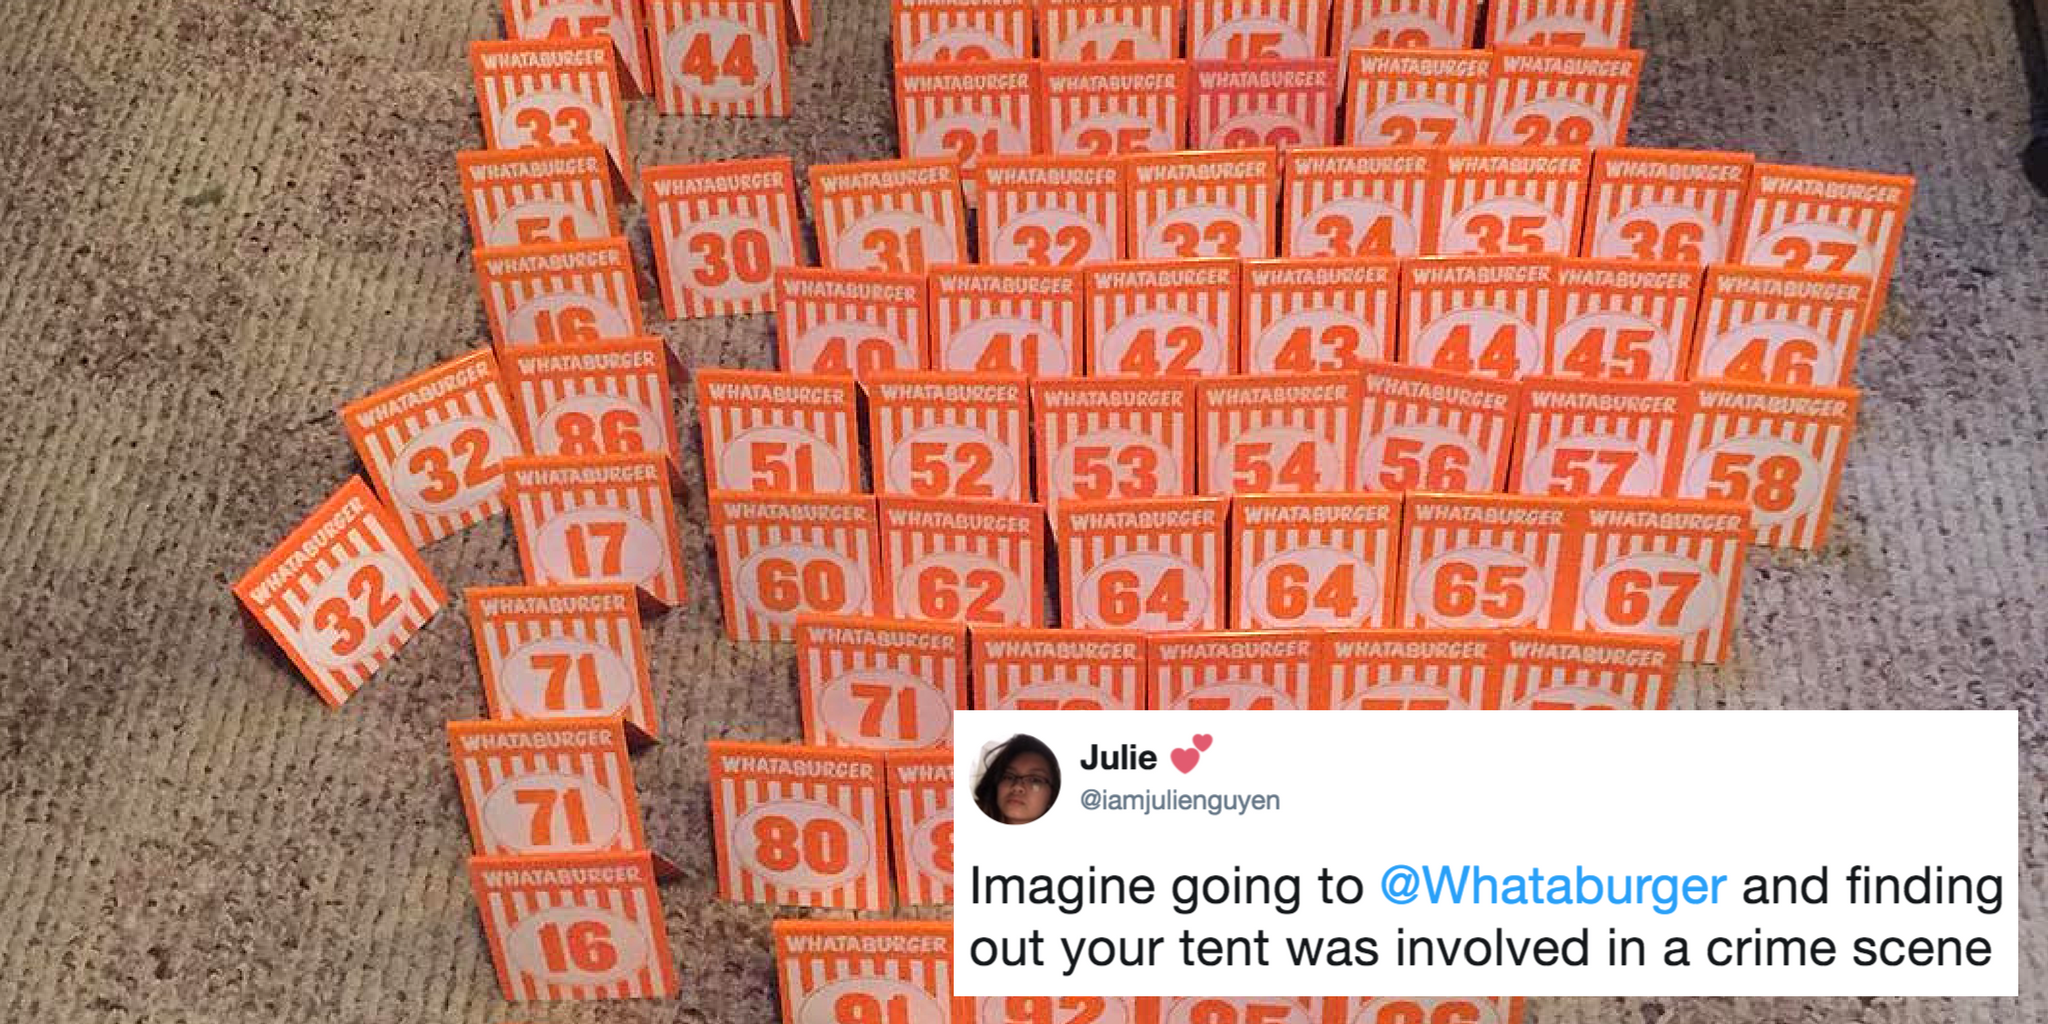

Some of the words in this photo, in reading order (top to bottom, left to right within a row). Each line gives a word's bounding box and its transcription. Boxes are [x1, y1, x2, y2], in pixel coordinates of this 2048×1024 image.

[482, 49, 604, 68] WHATABURGER
[682, 33, 758, 85] 44
[1361, 56, 1489, 77] WHATABURGER
[1504, 56, 1631, 76] WHATABURGER
[905, 73, 1029, 91] WHATABURGER
[1050, 73, 1175, 91] WHATABURGER
[1200, 70, 1327, 88] WHATABURGER
[516, 107, 593, 149] 33
[470, 156, 598, 181] WHATABURGER
[988, 168, 1116, 185] WHATABURGER
[1137, 161, 1267, 183] WHATABURGER
[1295, 157, 1427, 175] WHATABURGER
[1448, 157, 1582, 175] WHATABURGER
[1606, 160, 1742, 181] WHATABURGER
[653, 171, 784, 196] WHATABURGER
[821, 166, 951, 193] WHATABURGER
[1761, 176, 1901, 202] WHATABURGER
[1012, 225, 1092, 265] 32
[1162, 220, 1242, 258] 33
[1315, 215, 1395, 256] 34
[1465, 214, 1547, 256] 35
[1620, 220, 1704, 260] 36
[487, 249, 620, 275] WHATABURGER
[689, 229, 772, 286] 30
[863, 228, 925, 273] 31
[939, 275, 1073, 294] WHATABURGER
[1094, 268, 1231, 290] WHATABURGER
[1251, 267, 1388, 287] WHATABURGER
[1413, 265, 1551, 285] WHATABURGER
[783, 279, 917, 301] WHATABURGER
[1718, 276, 1861, 301] WHATABURGER
[975, 332, 1040, 373] 41
[1120, 327, 1202, 376] 42
[1274, 325, 1360, 373] 43
[1433, 324, 1520, 378] 44
[1564, 327, 1654, 380] 45
[518, 351, 655, 374] WHATABURGER
[1725, 338, 1818, 387] 46
[357, 360, 489, 428] WHATABURGER
[708, 383, 845, 404] WHATABURGER
[880, 384, 1019, 401] WHATABURGER
[1044, 390, 1184, 407] WHATABURGER
[1207, 384, 1349, 405] WHATABURGER
[1366, 374, 1509, 409] WHATABURGER
[1531, 391, 1677, 412] WHATABURGER
[1700, 390, 1849, 418] WHATABURGER
[555, 410, 644, 454] 86
[410, 429, 504, 502] 32
[517, 465, 657, 484] WHATABURGER
[752, 442, 814, 490] 51
[910, 442, 994, 496] 52
[1072, 445, 1158, 500] 53
[1232, 441, 1321, 493] 54
[1379, 437, 1471, 491] 56
[1551, 450, 1639, 496] 57
[1707, 453, 1803, 512] 58
[724, 504, 866, 521] WHATABURGER
[889, 509, 1030, 532] WHATABURGER
[1070, 509, 1215, 531] WHATABURGER
[1245, 505, 1389, 523] WHATABURGER
[1415, 504, 1563, 525] WHATABURGER
[1589, 508, 1742, 531] WHATABURGER
[250, 497, 365, 604] WHATABURGER
[565, 522, 626, 576] 17
[757, 558, 845, 612] 60
[918, 566, 1006, 622] 62
[1098, 568, 1189, 625] 64
[1266, 564, 1358, 619] 64
[1433, 562, 1528, 619] 65
[1604, 569, 1701, 627] 67
[313, 565, 401, 656] 32
[483, 595, 626, 616] WHATABURGER
[808, 626, 955, 648] WHATABURGER
[1160, 640, 1311, 660] WHATABURGER
[984, 641, 1137, 660] WHATABURGER
[1335, 641, 1487, 660] WHATABURGER
[1509, 640, 1667, 666] WHATABURGER
[530, 653, 603, 710] 71
[851, 682, 920, 740] 71
[461, 729, 613, 750] WHATABURGER
[721, 755, 874, 779] WHATABURGER
[515, 788, 591, 845] 71
[753, 815, 849, 875] 80
[483, 866, 642, 888] WHATABURGER
[538, 920, 617, 973] 16
[786, 935, 948, 952] WHATABURGER
